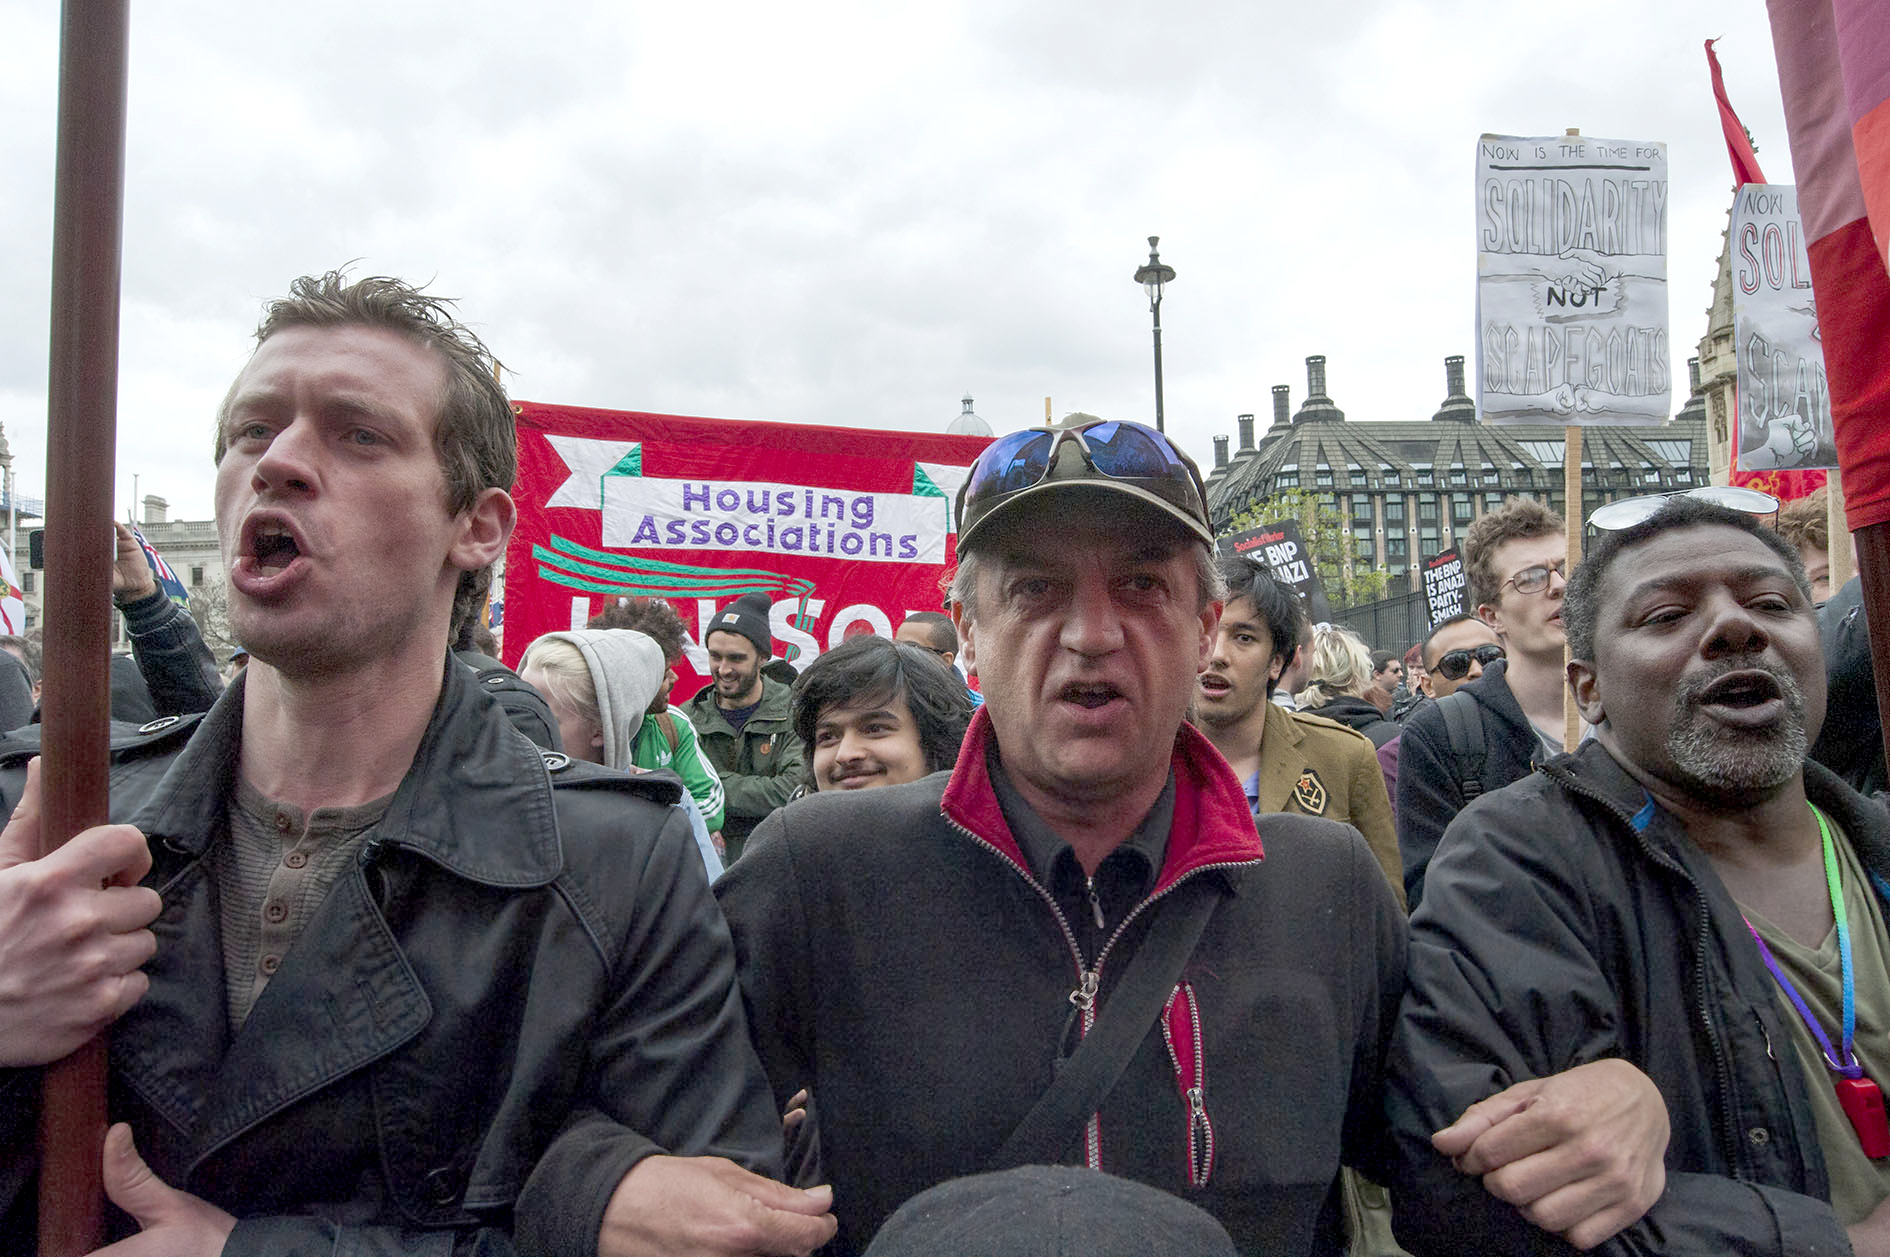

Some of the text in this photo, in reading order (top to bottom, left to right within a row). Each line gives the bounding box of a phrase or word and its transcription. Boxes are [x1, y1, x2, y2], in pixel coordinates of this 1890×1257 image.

[1482, 144, 1662, 161] NOW IS THE TIME FOR
[1744, 192, 1783, 215] NOW
[1483, 177, 1668, 255] SOLIDARITY
[1547, 286, 1607, 307] NOT
[1486, 325, 1668, 396] SCAPEGOATS
[683, 483, 874, 529] Housing
[630, 515, 918, 559] Associations
[1265, 541, 1298, 566] BNP
[1424, 567, 1444, 583] THE
[1443, 560, 1462, 577] BNP
[1426, 583, 1437, 597] IS
